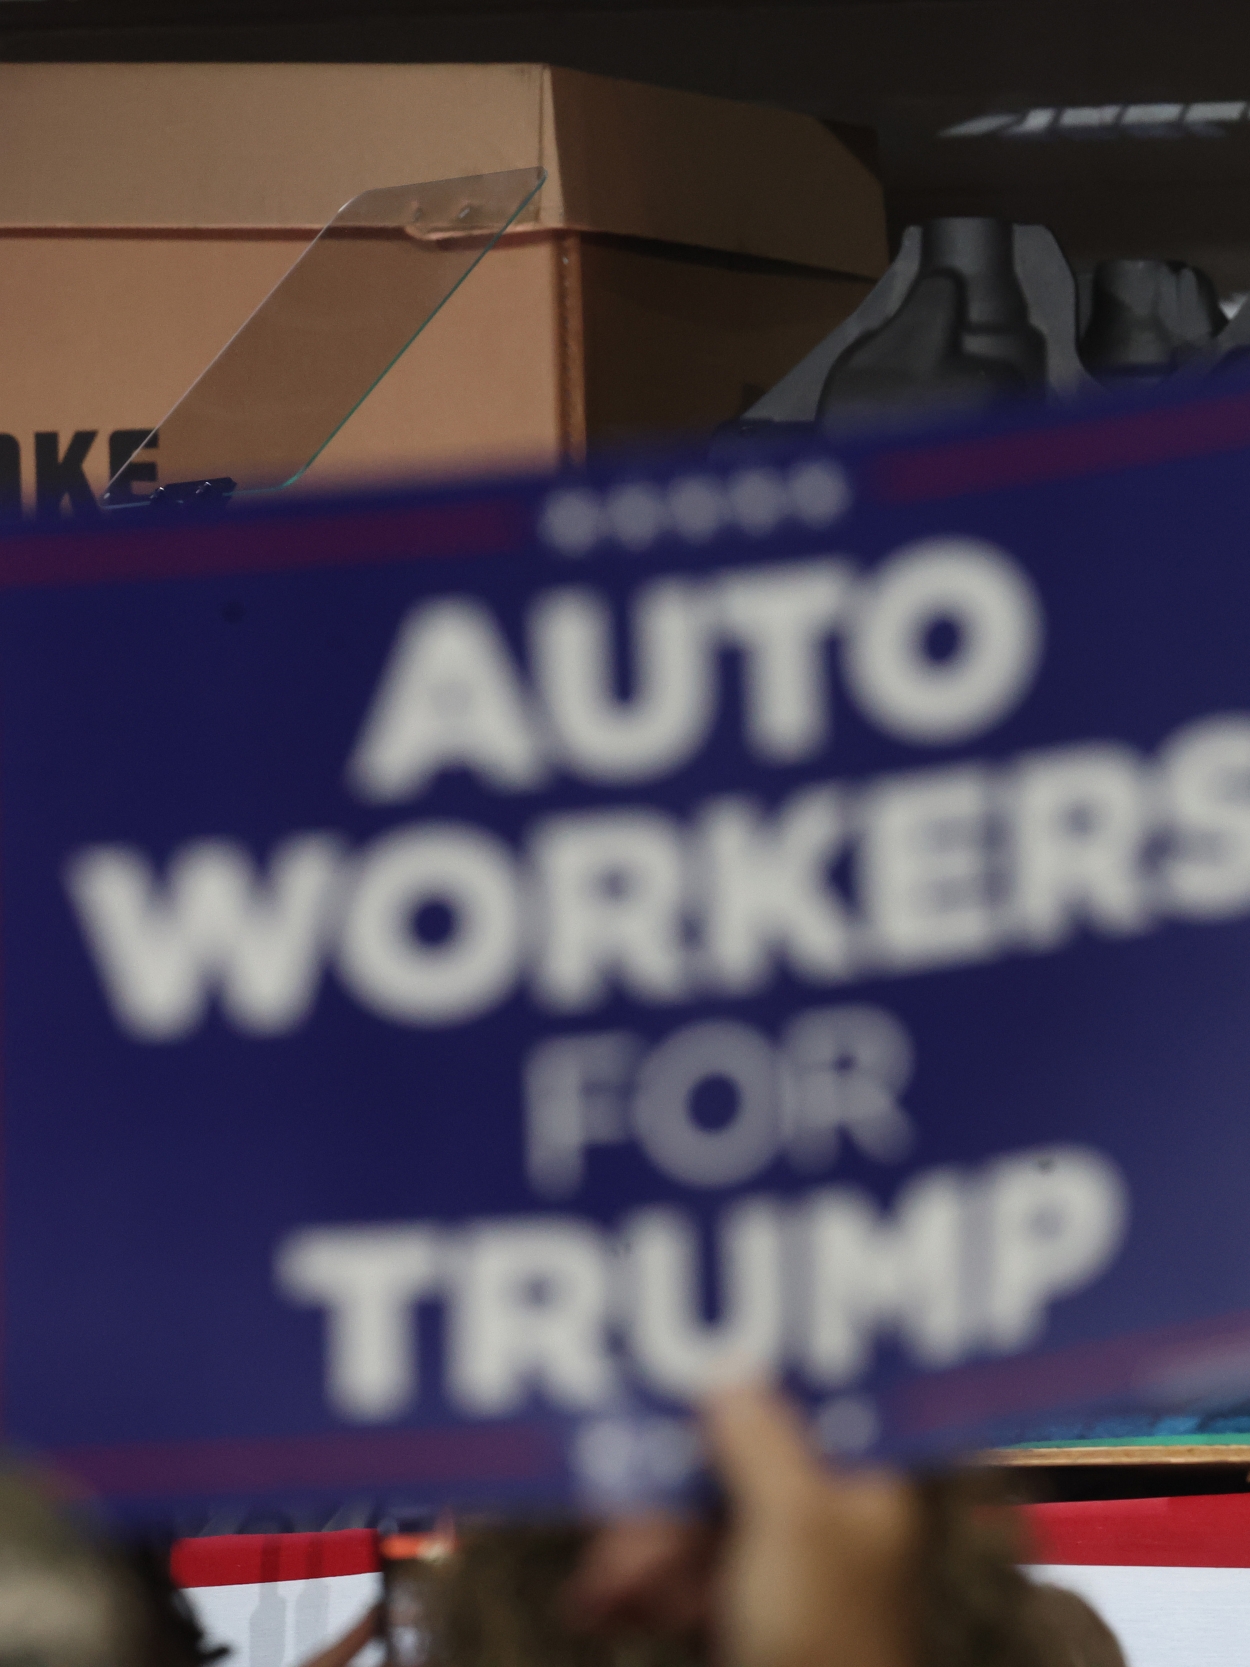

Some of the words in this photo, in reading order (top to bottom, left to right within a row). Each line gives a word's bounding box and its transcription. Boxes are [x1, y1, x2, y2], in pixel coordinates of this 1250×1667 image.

[352, 540, 1042, 800] AUTO
[525, 1008, 914, 1192] FOR
[278, 1147, 1130, 1419] TRUMP
